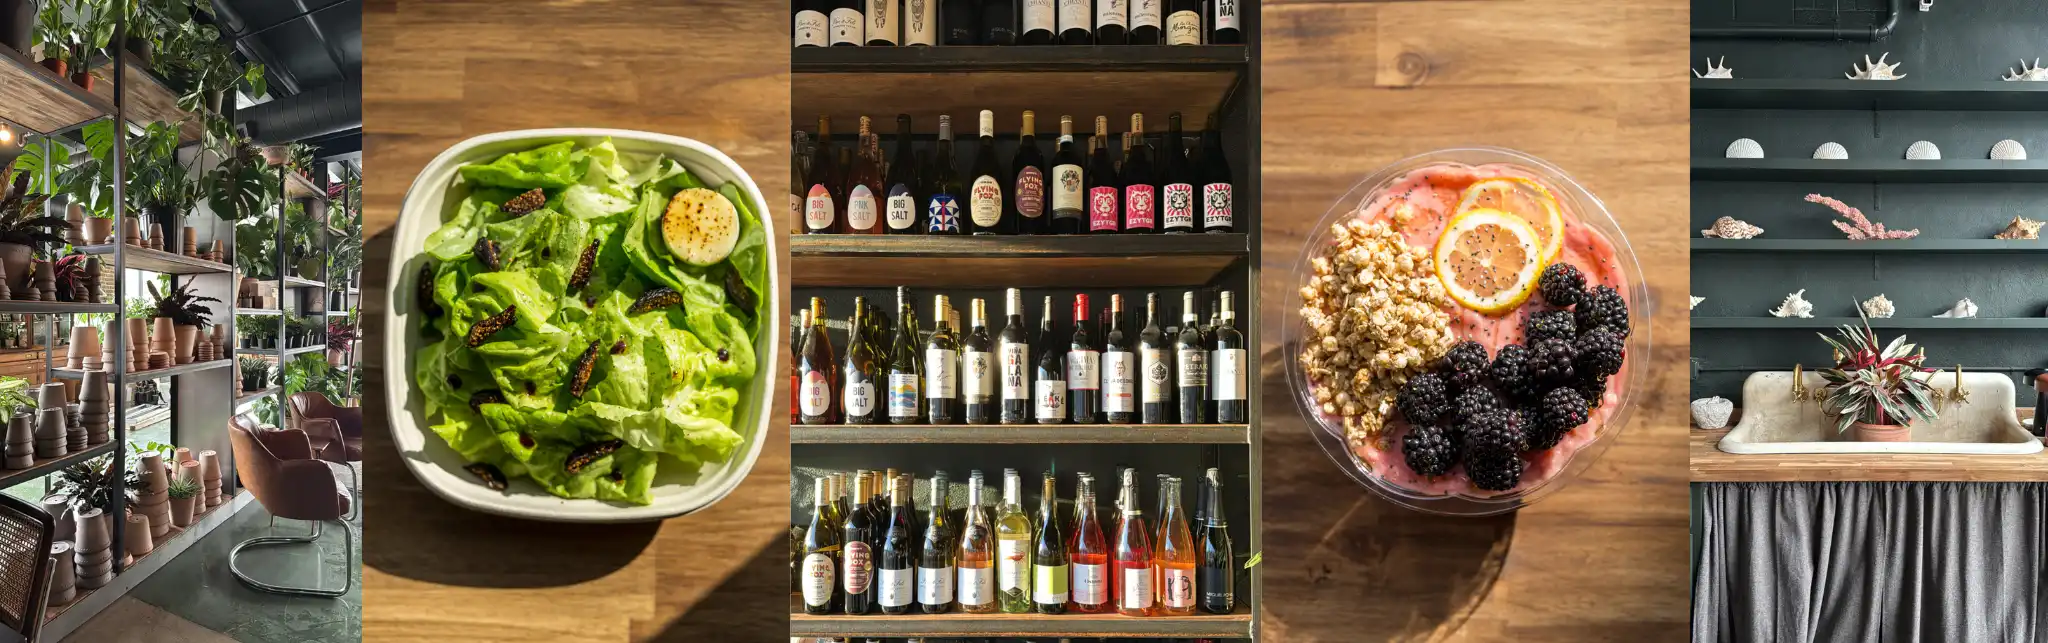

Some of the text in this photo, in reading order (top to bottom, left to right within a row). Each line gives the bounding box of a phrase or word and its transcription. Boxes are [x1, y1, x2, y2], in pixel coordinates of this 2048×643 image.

[978, 192, 994, 200] FOX
[812, 200, 824, 209] BIG
[893, 200, 905, 209] BIG
[810, 211, 827, 221] SALT
[853, 211, 871, 221] SALT
[891, 211, 908, 220] SALT
[853, 387, 865, 395] BIG
